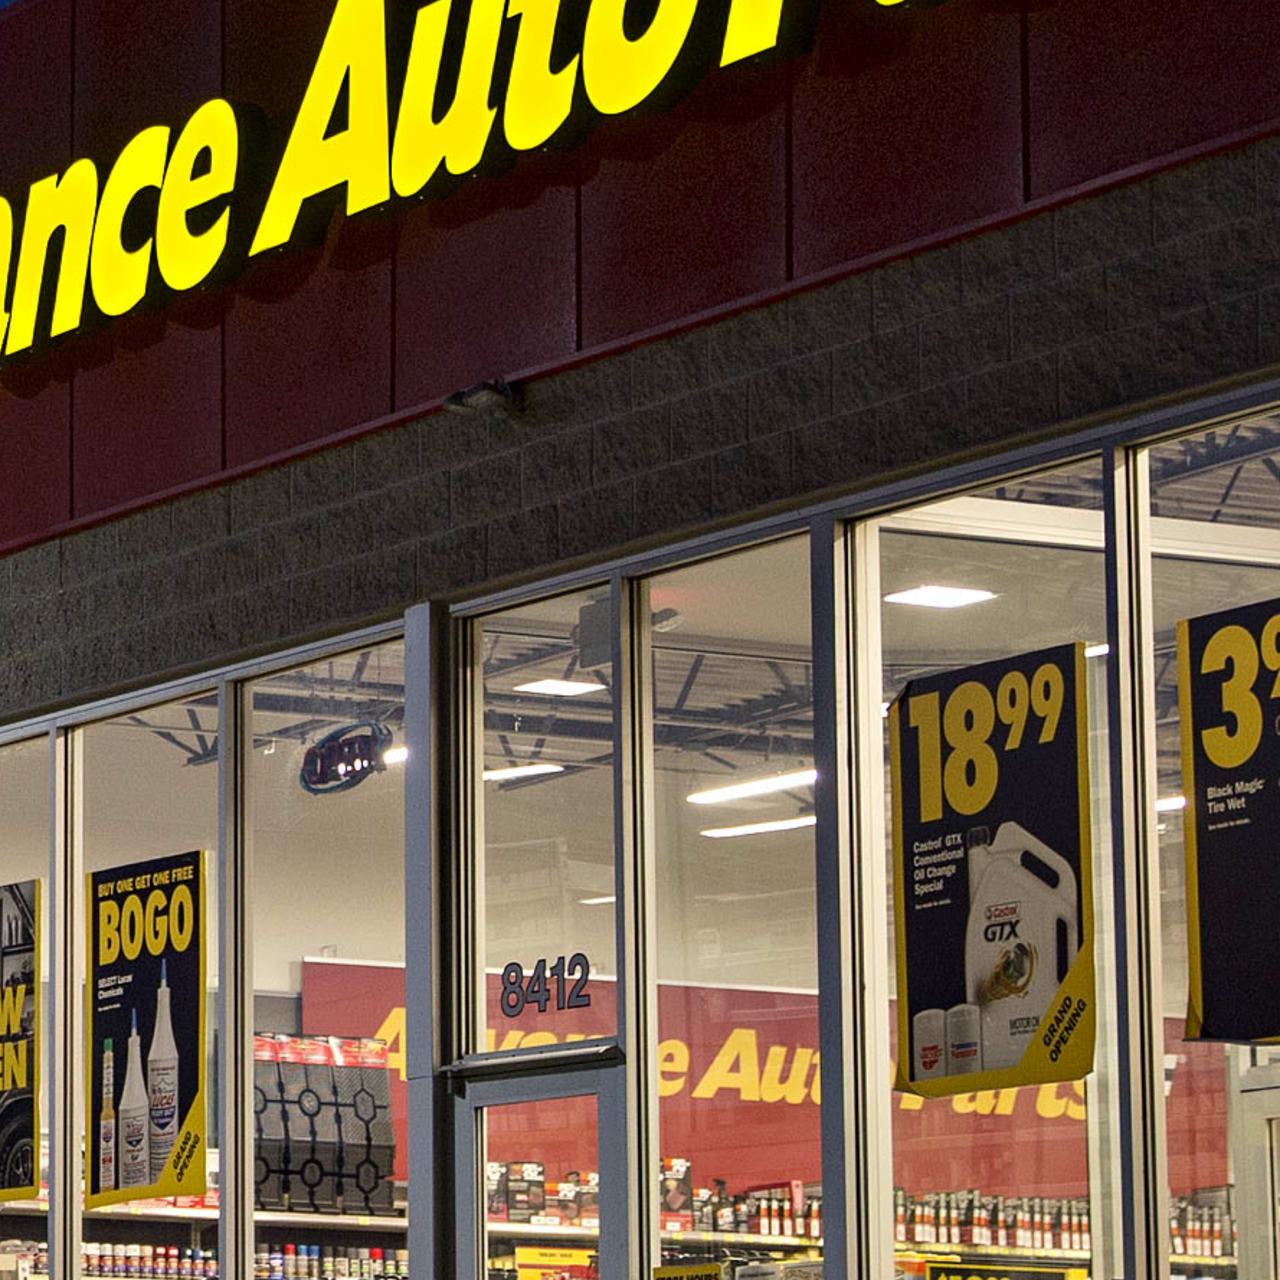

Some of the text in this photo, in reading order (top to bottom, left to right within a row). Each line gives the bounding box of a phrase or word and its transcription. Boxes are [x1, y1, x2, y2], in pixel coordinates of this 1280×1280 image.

[1207, 778, 1264, 800] Black Magic
[1207, 796, 1246, 815] Tire Wet
[913, 833, 962, 853] Castrol GTX
[913, 847, 964, 867] Conventional
[98, 866, 194, 897] BUY ONE GET ONE FREE
[913, 864, 957, 880] Oil Change
[914, 879, 944, 896] Special
[992, 906, 1018, 918] Castrol
[99, 884, 194, 966] BOGO
[984, 920, 1020, 942] GTX
[500, 952, 591, 1018] 8412
[1042, 996, 1072, 1047] GRAND
[1049, 998, 1087, 1062] OPENING
[173, 1131, 191, 1170] GRAND
[176, 1134, 200, 1182] OPENING
